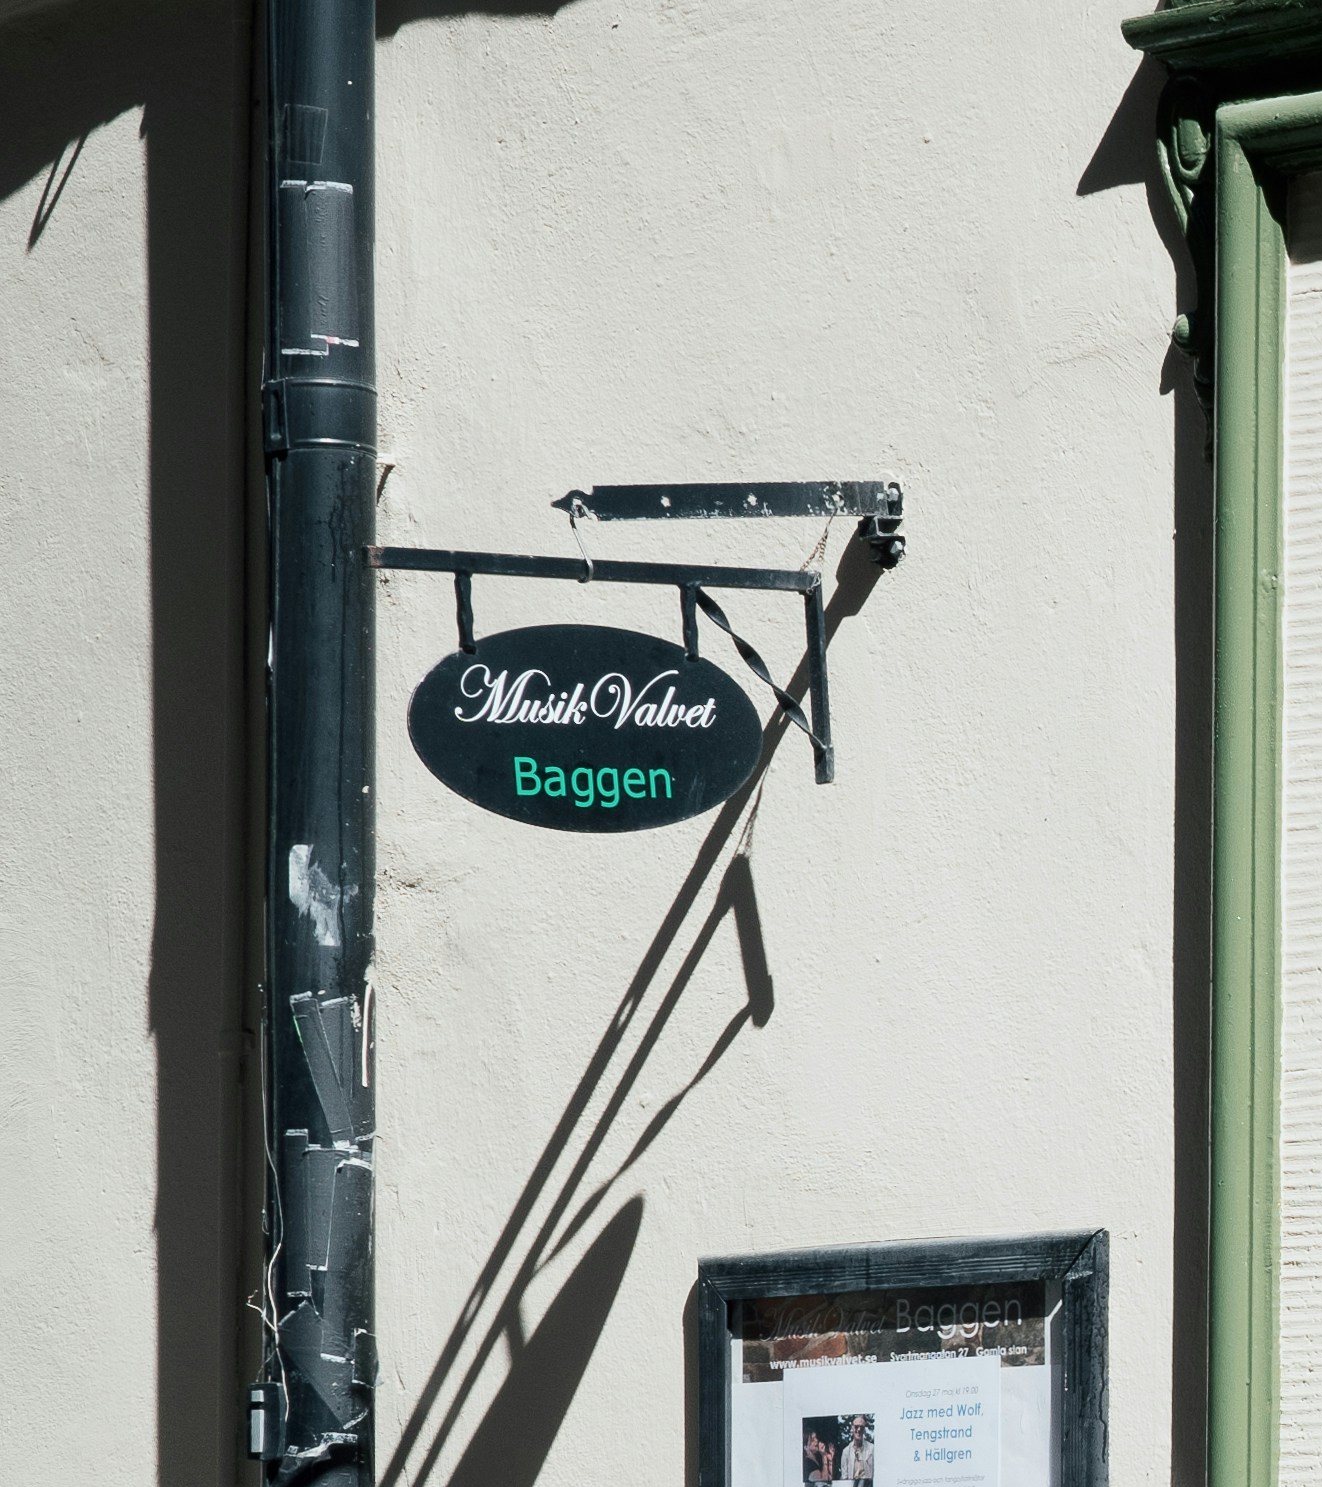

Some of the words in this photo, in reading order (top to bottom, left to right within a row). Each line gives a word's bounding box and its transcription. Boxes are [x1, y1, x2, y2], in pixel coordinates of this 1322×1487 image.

[454, 663, 589, 725] Musik
[590, 669, 717, 730] Valvet
[513, 755, 674, 808] Baggen
[895, 1298, 1023, 1340] Baggen
[957, 1347, 969, 1358] 27
[899, 1407, 924, 1420] Jazz
[927, 1404, 953, 1418] med
[956, 1402, 984, 1417] Wolf,
[910, 1425, 973, 1443] Tengstrand
[913, 1450, 921, 1462] &
[925, 1447, 972, 1464] Hällgren
